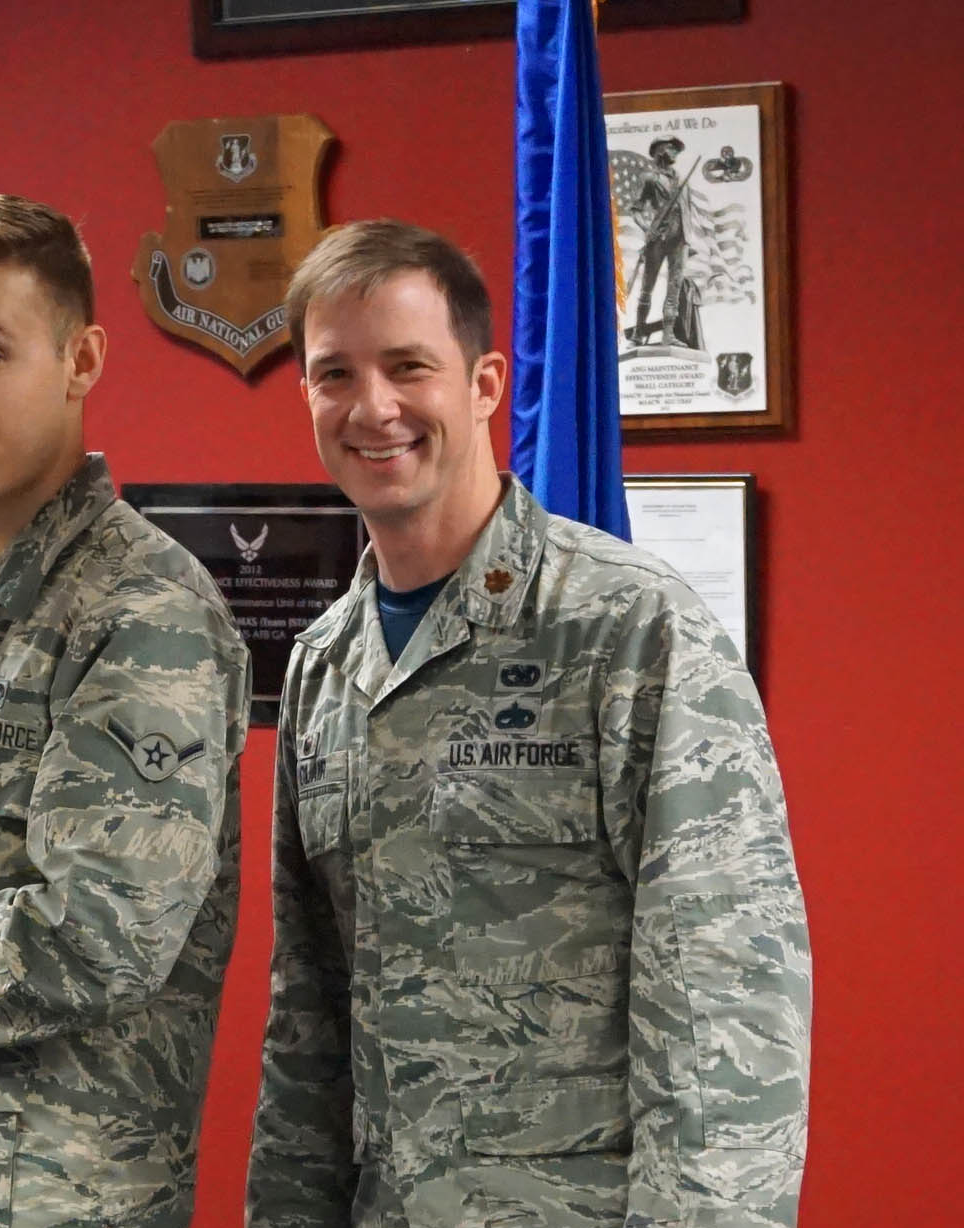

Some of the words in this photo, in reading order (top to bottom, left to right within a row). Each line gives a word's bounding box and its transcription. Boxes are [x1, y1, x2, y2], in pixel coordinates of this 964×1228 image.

[652, 122, 662, 131] in
[665, 118, 681, 131] All
[683, 118, 698, 130] We
[701, 117, 717, 129] Do
[172, 304, 195, 324] AIR
[199, 309, 265, 350] NATIONAL
[266, 306, 287, 331] GU
[647, 363, 700, 372] MAINTENANCE
[625, 373, 677, 382] EFFECTIVENESS
[678, 372, 705, 381] AWARD
[658, 381, 695, 389] CATEGORY
[236, 578, 300, 588] EFFECTIVENESS
[303, 578, 338, 588] AWARD
[297, 600, 306, 608] of
[308, 600, 323, 608] the
[272, 630, 285, 640] GA
[480, 742, 512, 767] AIR
[516, 742, 581, 767] FORCE
